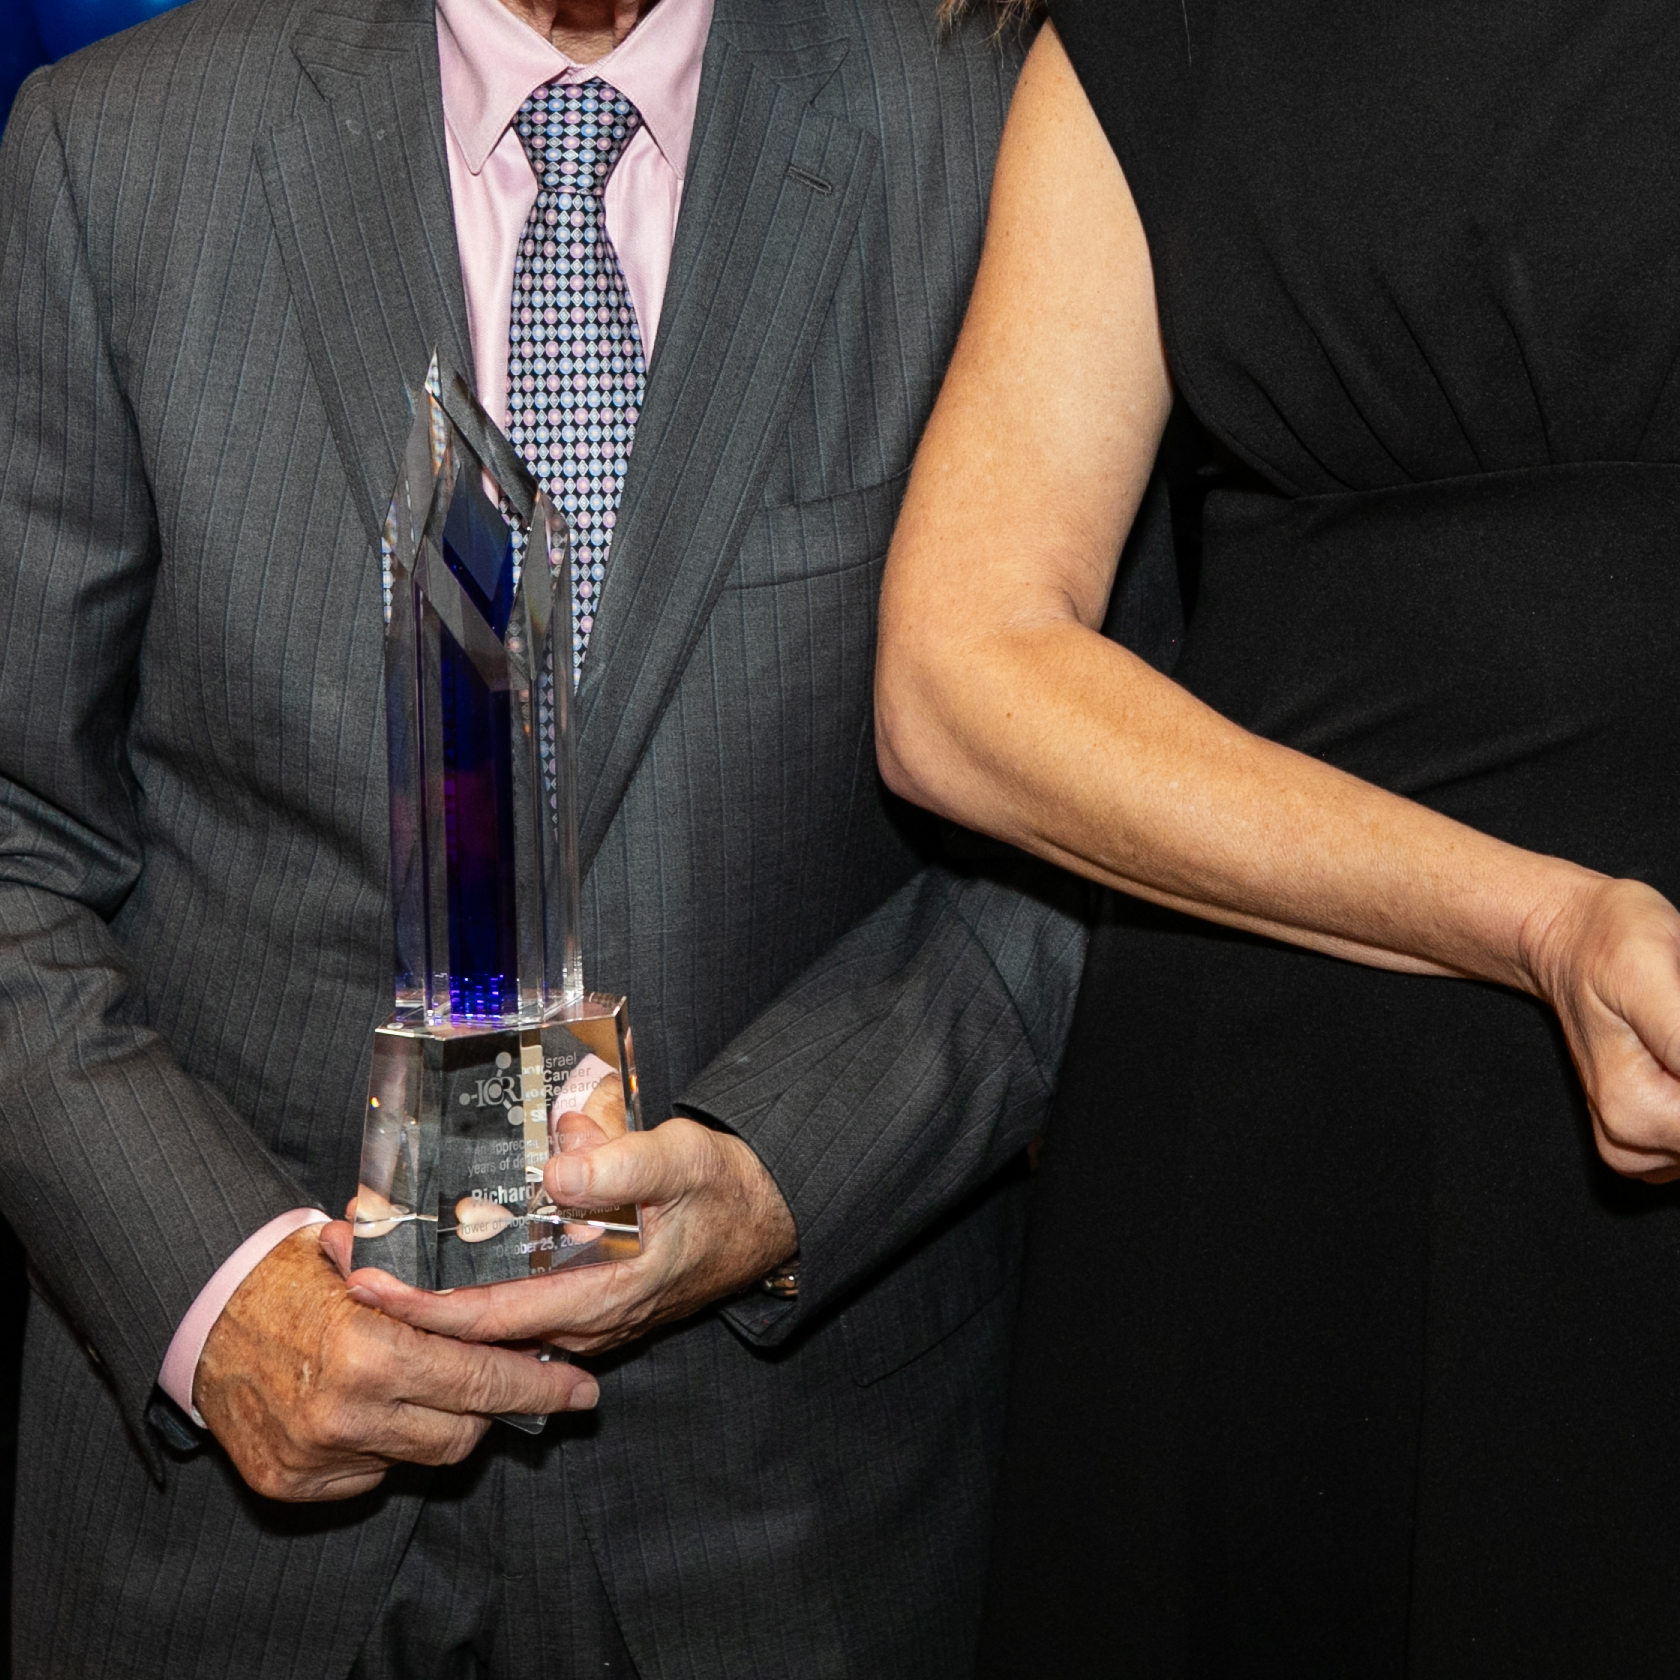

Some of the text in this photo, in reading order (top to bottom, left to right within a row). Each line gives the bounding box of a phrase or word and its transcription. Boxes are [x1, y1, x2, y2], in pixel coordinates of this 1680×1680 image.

[541, 1052, 577, 1070] Israel
[542, 1066, 591, 1083] Cancer
[544, 1096, 577, 1110] Fund
[499, 1157, 511, 1171] of
[471, 1184, 536, 1206] Richard
[539, 1235, 559, 1252] 25,
